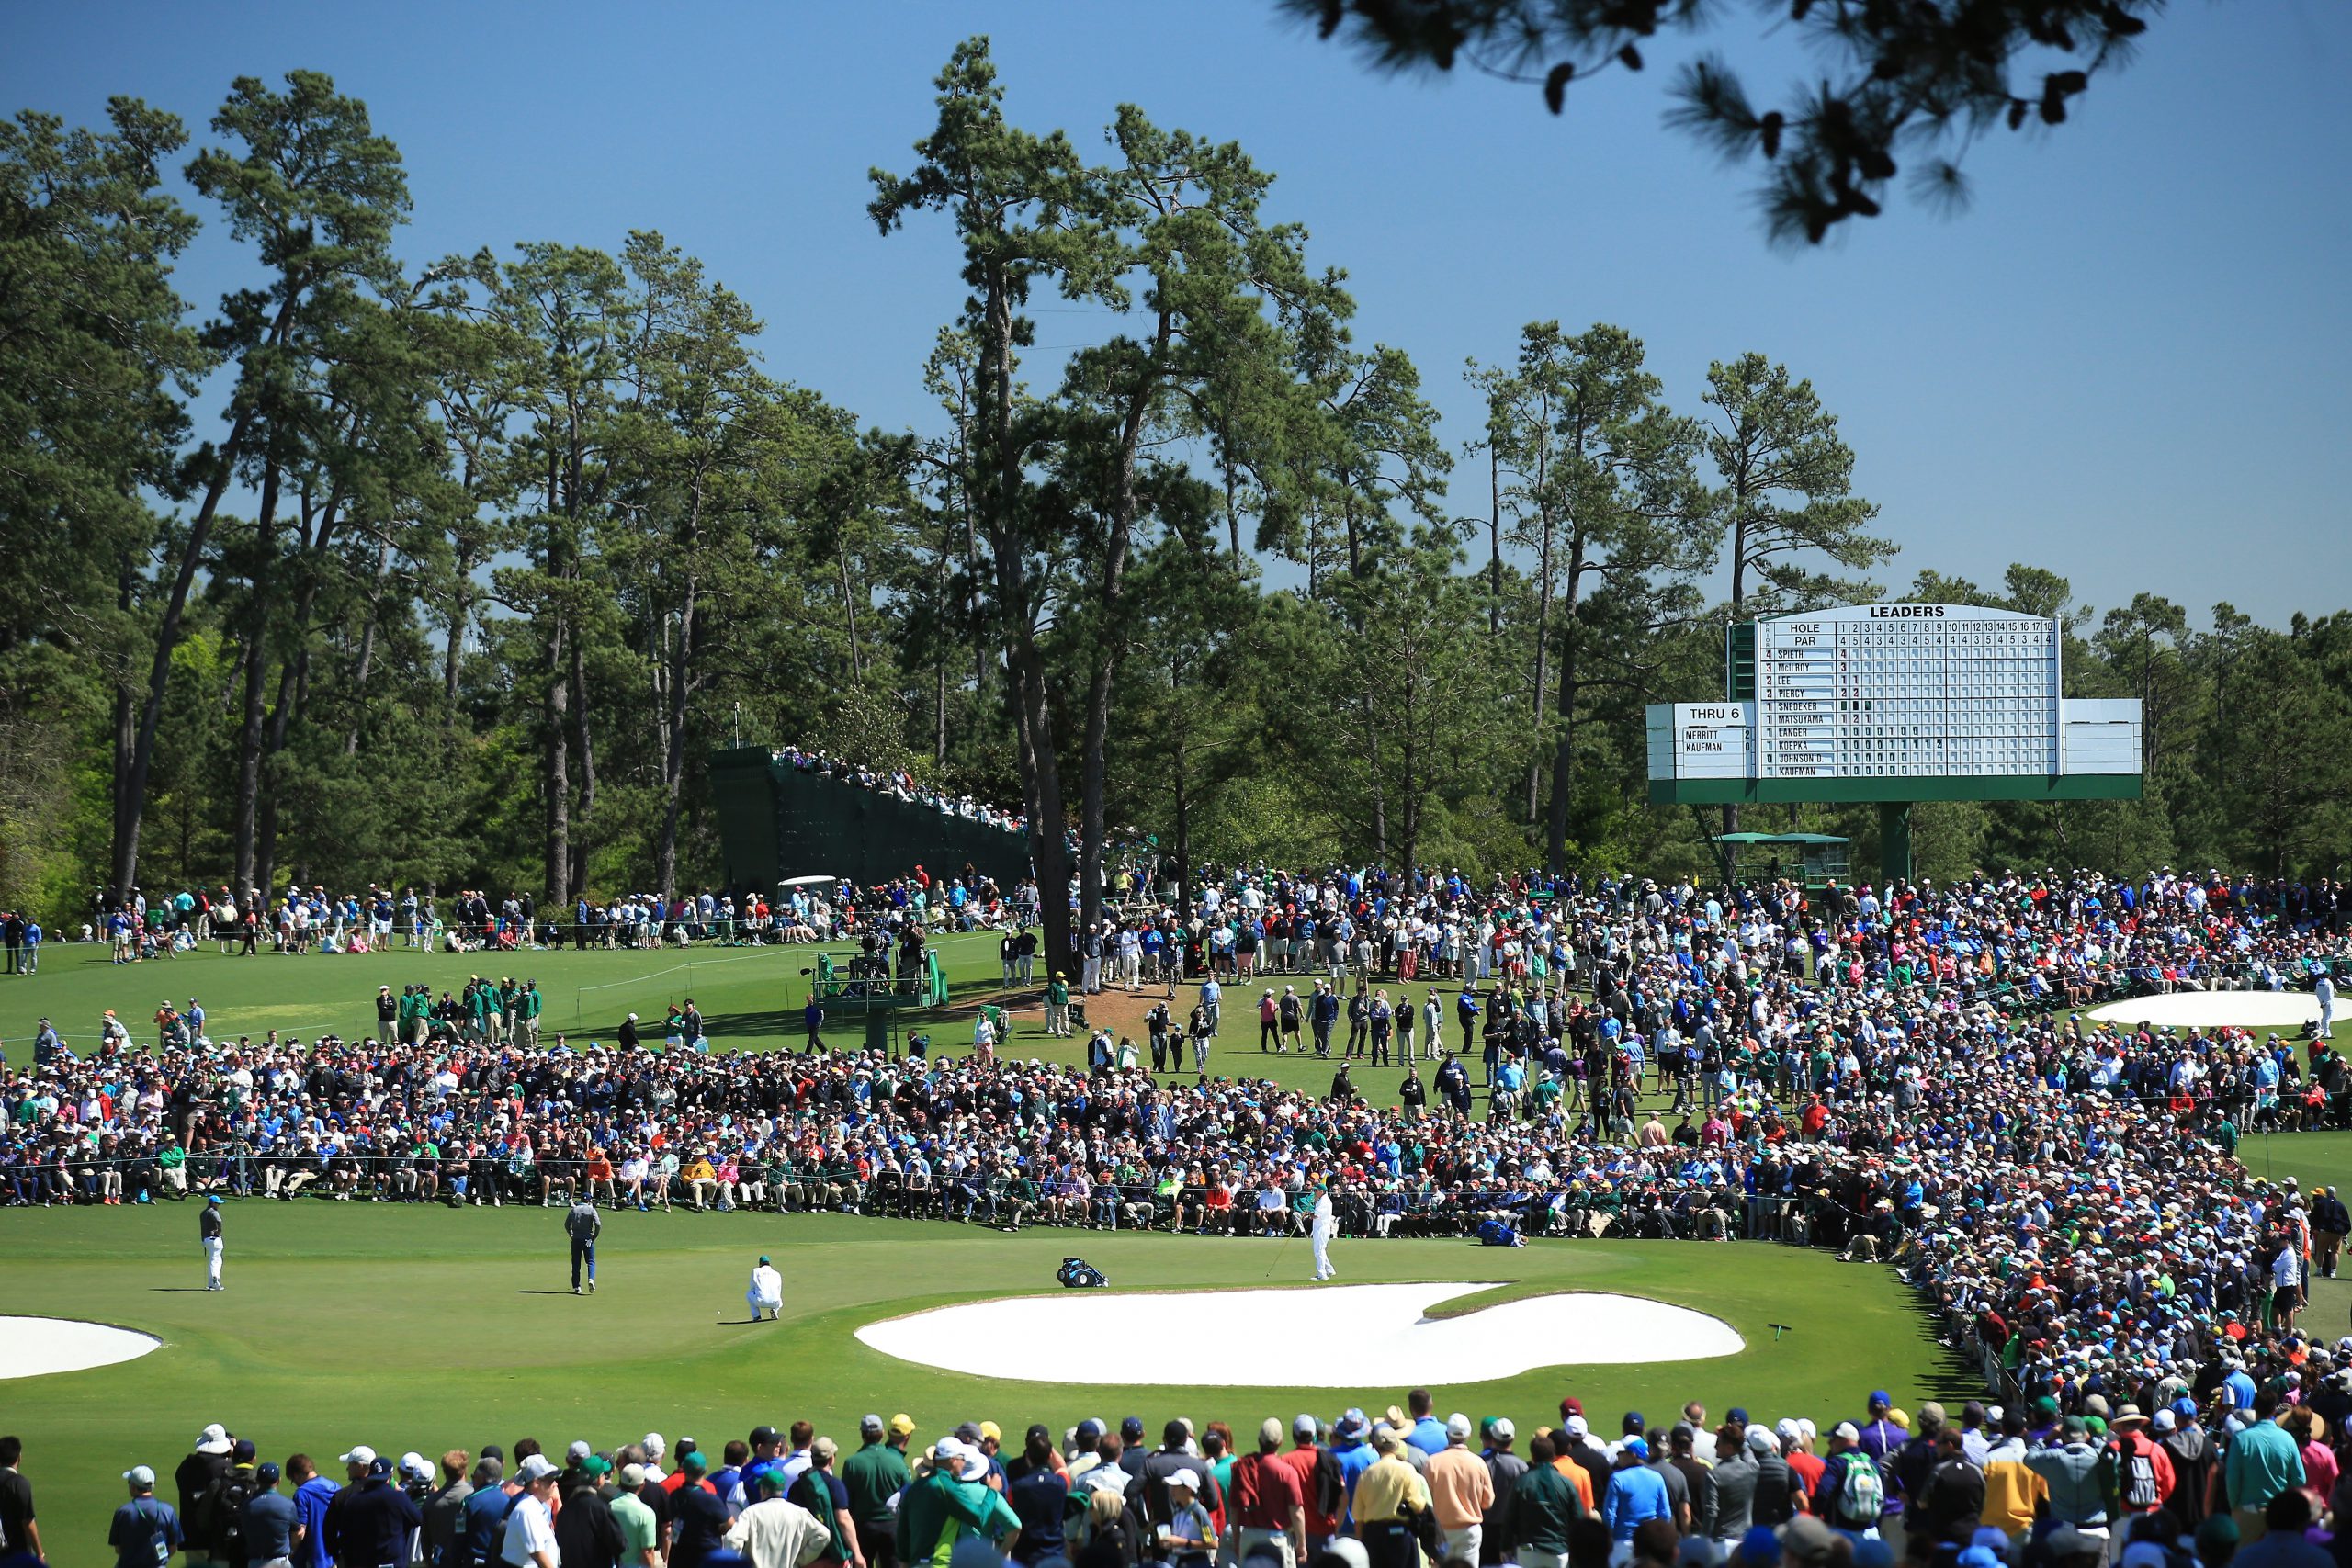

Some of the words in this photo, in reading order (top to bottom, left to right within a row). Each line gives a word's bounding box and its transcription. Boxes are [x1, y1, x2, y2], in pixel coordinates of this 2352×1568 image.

[1871, 606, 1944, 617] LEADERS
[1791, 624, 1820, 632] HOLE
[1841, 624, 1844, 632] 1
[1853, 624, 1858, 632] 2
[1865, 624, 1870, 632] 3
[1877, 624, 1882, 632] 4
[1889, 624, 1894, 632] 5
[1901, 624, 1906, 632] 6
[1913, 623, 1917, 632] 7
[1924, 623, 1929, 632] 8
[1937, 623, 1942, 631] 9
[1949, 623, 1957, 631] 10
[1962, 623, 1968, 631] 11
[1973, 623, 1980, 631] 12
[1985, 623, 1993, 631] 13
[1997, 623, 2005, 631] 14
[2009, 622, 2017, 631] 15
[2021, 622, 2029, 631] 16
[2033, 622, 2040, 630] 17
[2045, 622, 2053, 630] 18
[1795, 637, 1815, 645] PAR
[1841, 637, 1846, 645] 4
[1853, 637, 1858, 645] 5
[1865, 637, 1870, 645] 4
[1950, 636, 1955, 644] 4
[1962, 636, 1967, 644] 4
[1974, 636, 1979, 644] 3
[1986, 636, 1991, 644] 5
[1766, 650, 1771, 659] 4
[1778, 650, 1803, 659] SPIETH
[1841, 649, 1846, 658] 4
[1767, 663, 1771, 672] 3
[1778, 663, 1809, 672] McILROY
[1841, 663, 1846, 671] 3
[1767, 676, 1772, 685] 2
[1778, 676, 1790, 685] LEE
[1841, 675, 1846, 684] 1
[1853, 675, 1858, 684] 1
[1779, 689, 1804, 697] PIERCY
[1842, 688, 1847, 697] 2
[1854, 688, 1858, 697] 2
[1767, 702, 1772, 711] 1
[1779, 702, 1817, 711] SNEDEKER
[1690, 709, 1724, 719] THRU
[1731, 708, 1739, 719] 6
[1767, 715, 1772, 724] 1
[1778, 715, 1823, 724] MATSUYAMA
[1841, 714, 1847, 723] 1
[1854, 714, 1858, 723] 2
[1866, 714, 1870, 723] 1
[1686, 731, 1718, 739] MERRITT
[1745, 730, 1750, 739] 2
[1767, 728, 1772, 737] 1
[1779, 728, 1807, 737] LANGER
[1841, 727, 1847, 736] 1
[1854, 727, 1858, 736] 0
[1866, 727, 1870, 735] 0
[1878, 727, 1882, 735] 0
[1889, 727, 1894, 735] 1
[1901, 727, 1906, 735] 0
[1913, 727, 1918, 735] 0
[1687, 743, 1721, 752] KAUFMAN
[1746, 742, 1750, 751] 0
[1767, 741, 1772, 750] 1
[1779, 741, 1807, 750] KOEPKA
[1841, 741, 1847, 749] 1
[1854, 740, 1858, 749] 0
[1866, 740, 1870, 749] 0
[1878, 740, 1882, 749] 0
[1889, 740, 1894, 749] 1
[1901, 740, 1906, 749] 1
[1913, 740, 1918, 749] 1
[1925, 740, 1930, 748] 1
[1937, 740, 1942, 748] 2
[1767, 754, 1772, 763] 0
[1780, 754, 1813, 763] JOHNSON
[1817, 754, 1824, 762] D.
[1842, 753, 1847, 762] 1
[1854, 753, 1859, 762] 1
[1866, 753, 1871, 762] 0
[1878, 753, 1883, 762] 0
[1890, 753, 1895, 762] 0
[1902, 753, 1907, 762] 0
[1768, 767, 1772, 775] 1
[1780, 767, 1815, 775] KAUFMAN
[1842, 766, 1847, 775] 1
[1854, 766, 1859, 775] 0
[1866, 766, 1871, 775] 0
[1878, 766, 1883, 775] 0
[1890, 766, 1895, 775] 0
[1902, 766, 1907, 774] 0
